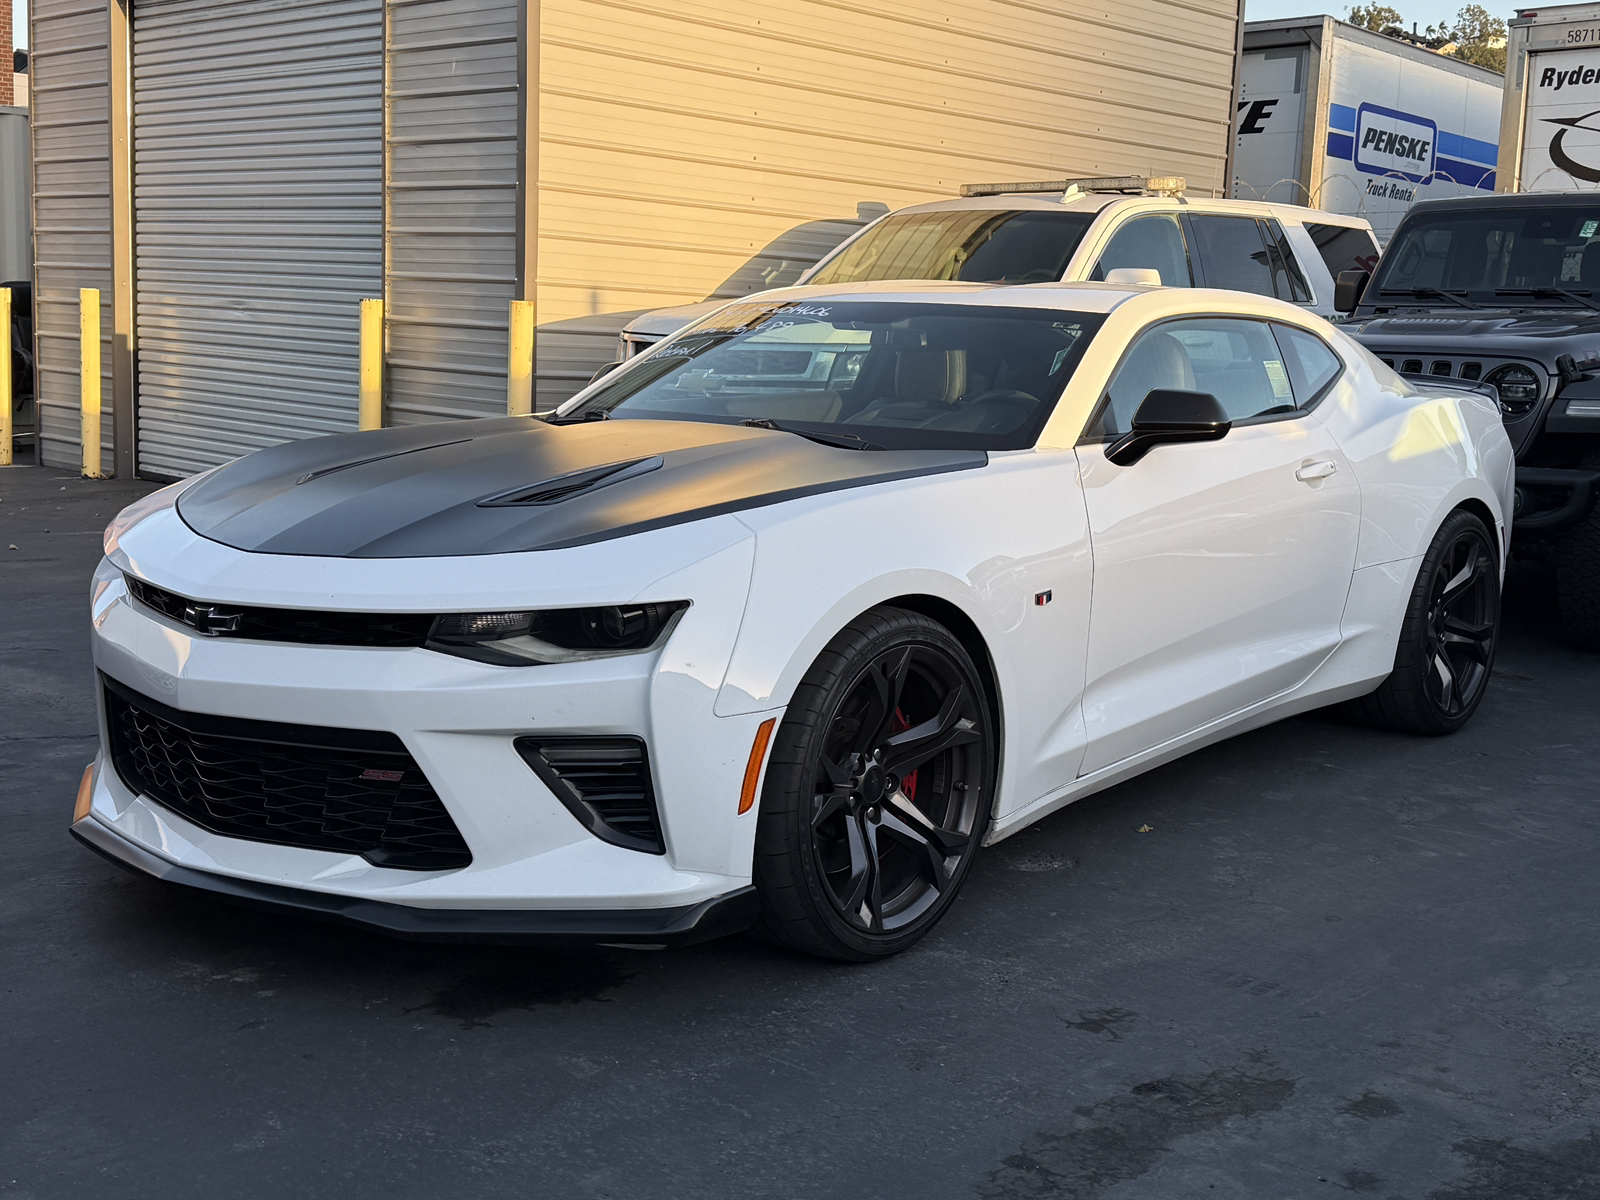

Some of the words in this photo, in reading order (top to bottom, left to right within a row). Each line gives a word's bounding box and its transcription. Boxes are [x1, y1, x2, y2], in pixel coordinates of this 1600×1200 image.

[1539, 65, 1600, 91] Ryder
[1361, 127, 1430, 162] PENSKE
[1367, 178, 1389, 198] Truck
